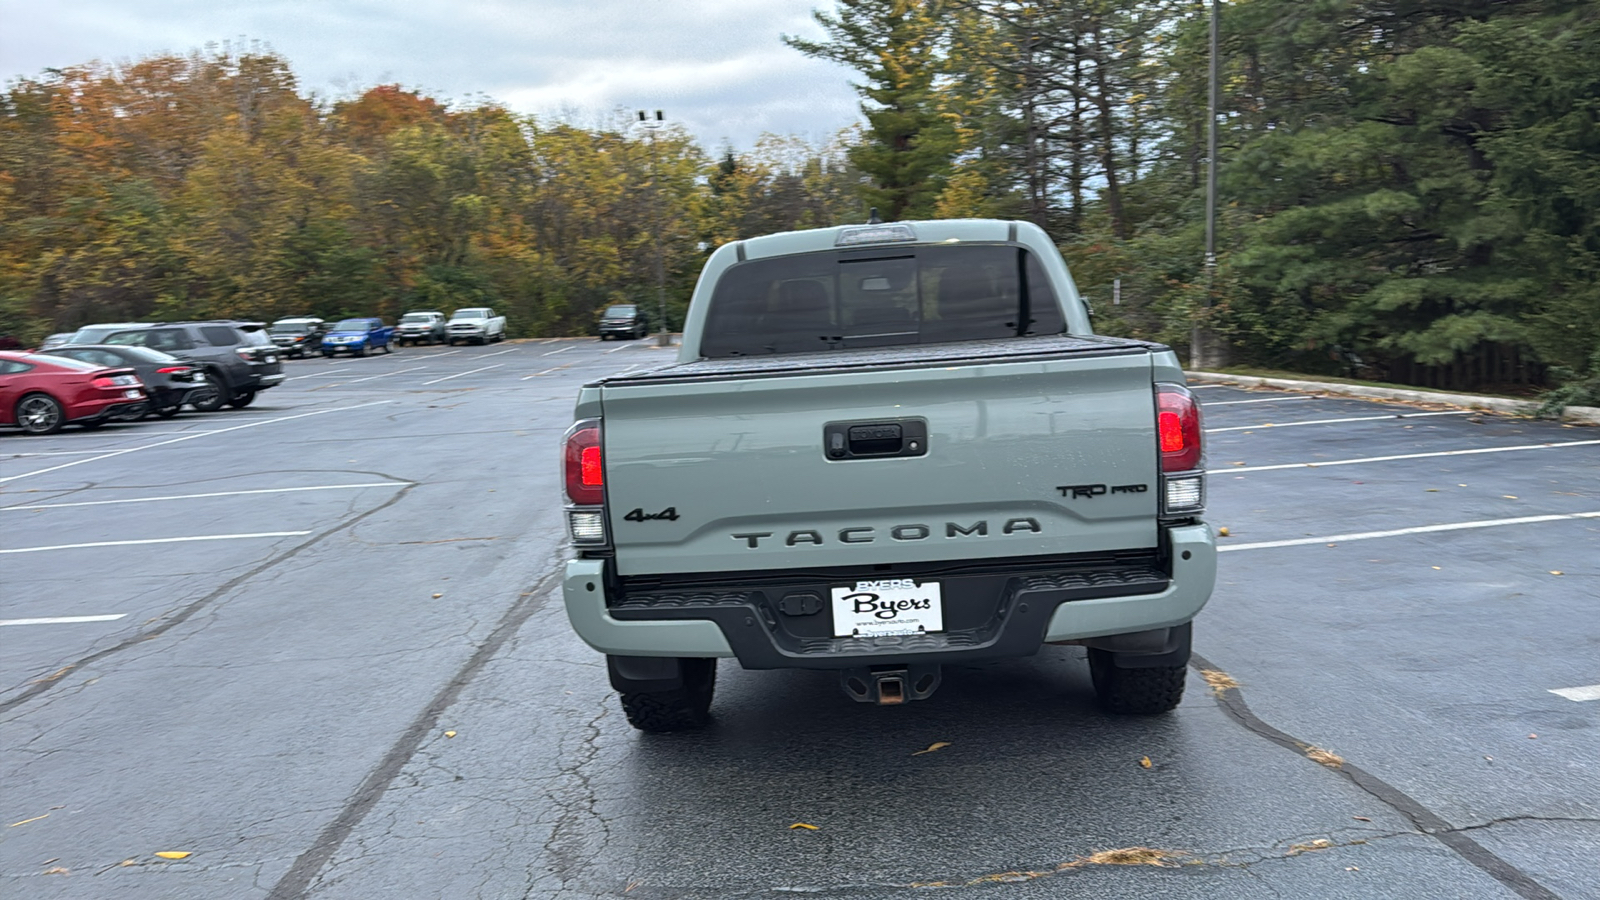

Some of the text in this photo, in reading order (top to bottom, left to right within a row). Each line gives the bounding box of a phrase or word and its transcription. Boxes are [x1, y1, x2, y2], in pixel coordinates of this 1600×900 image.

[852, 427, 898, 439] TOYOTA
[1056, 484, 1148, 499] TRD PRO
[623, 506, 681, 522] 4x4
[730, 517, 1041, 549] TACOMA
[856, 578, 914, 591] BYERS
[841, 593, 931, 619] Byers
[855, 618, 920, 626] www.byersauto.com
